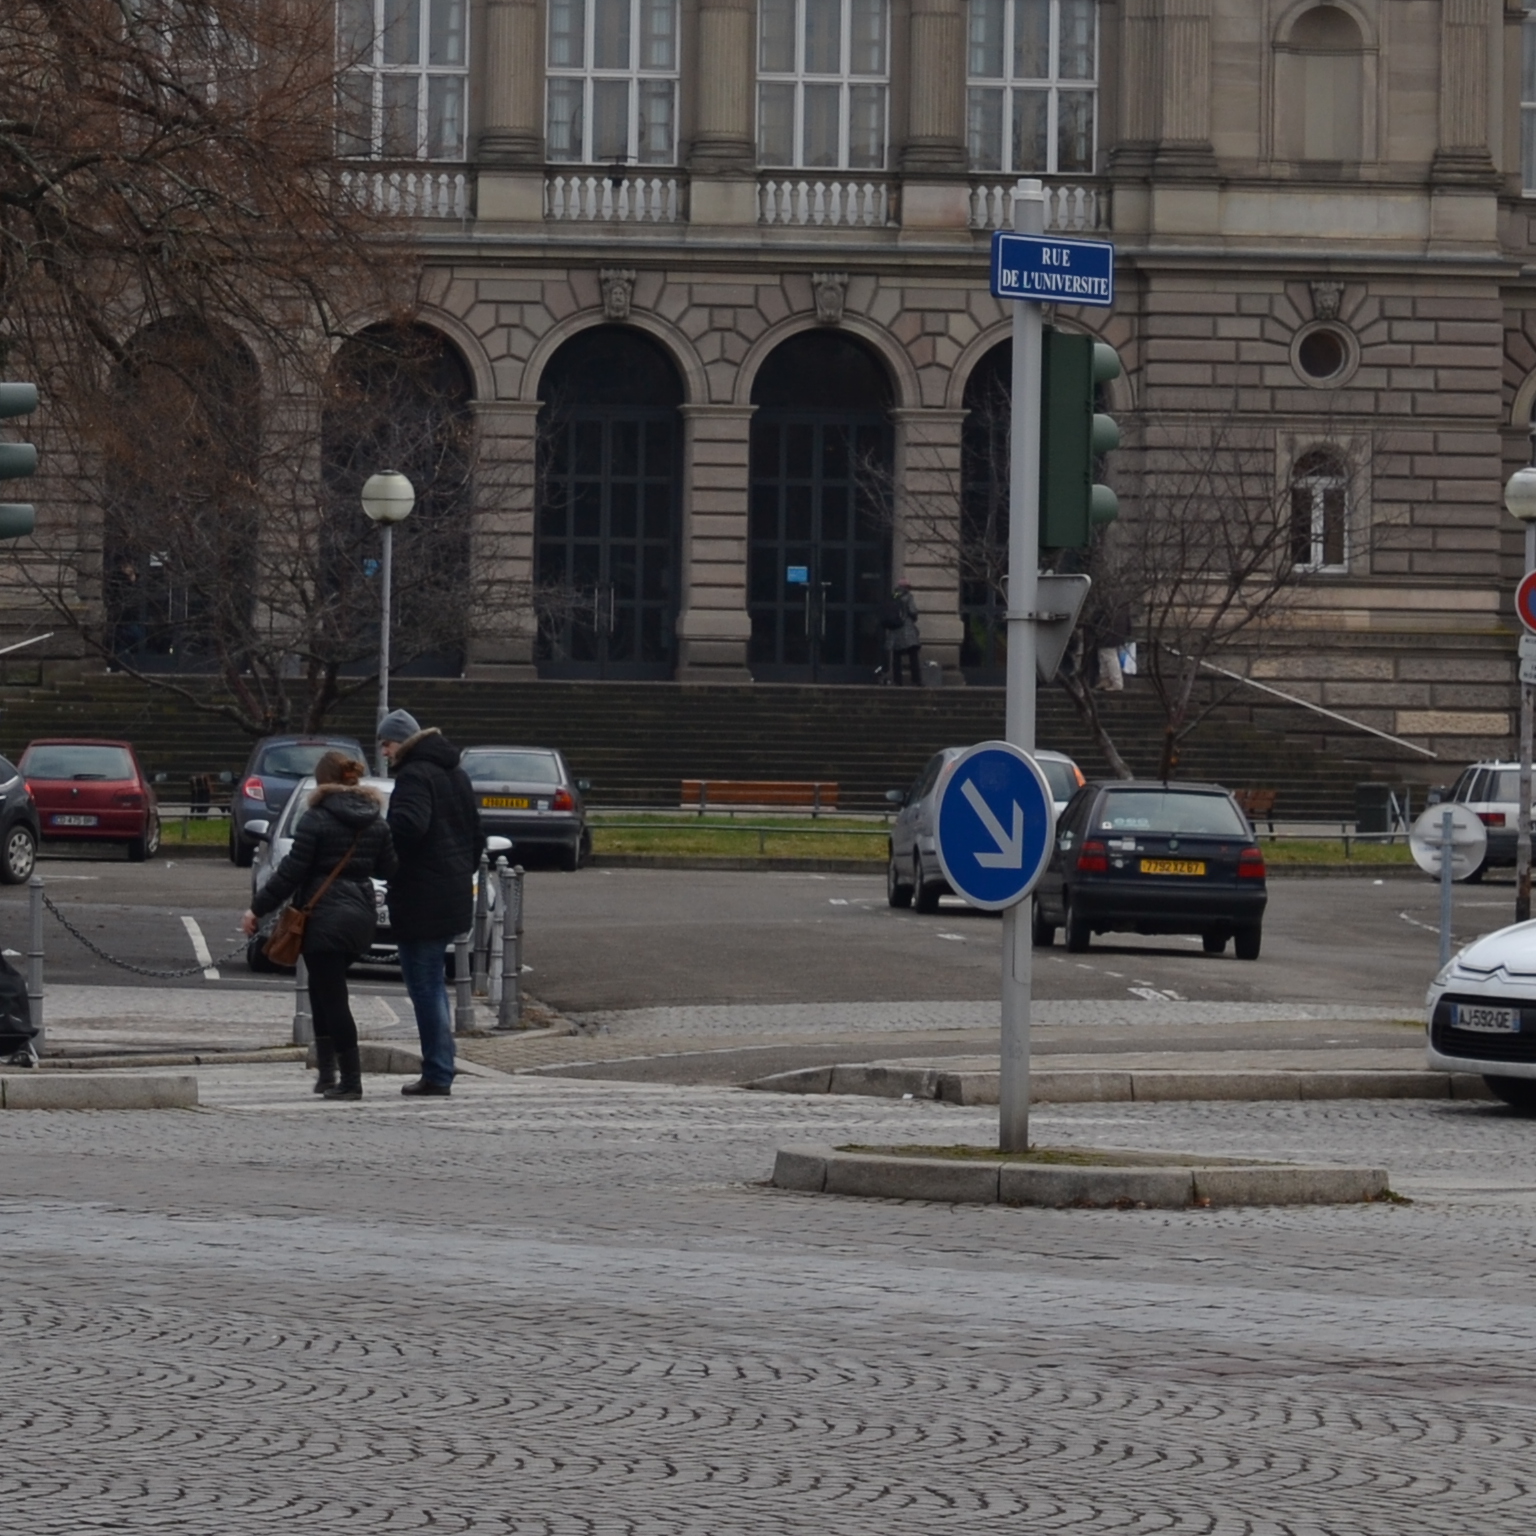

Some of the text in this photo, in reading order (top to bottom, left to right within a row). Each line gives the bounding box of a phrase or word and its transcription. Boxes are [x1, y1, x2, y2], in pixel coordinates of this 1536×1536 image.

[1041, 247, 1071, 267] RUE
[1002, 269, 1109, 296] DE L'UNIVERSITE
